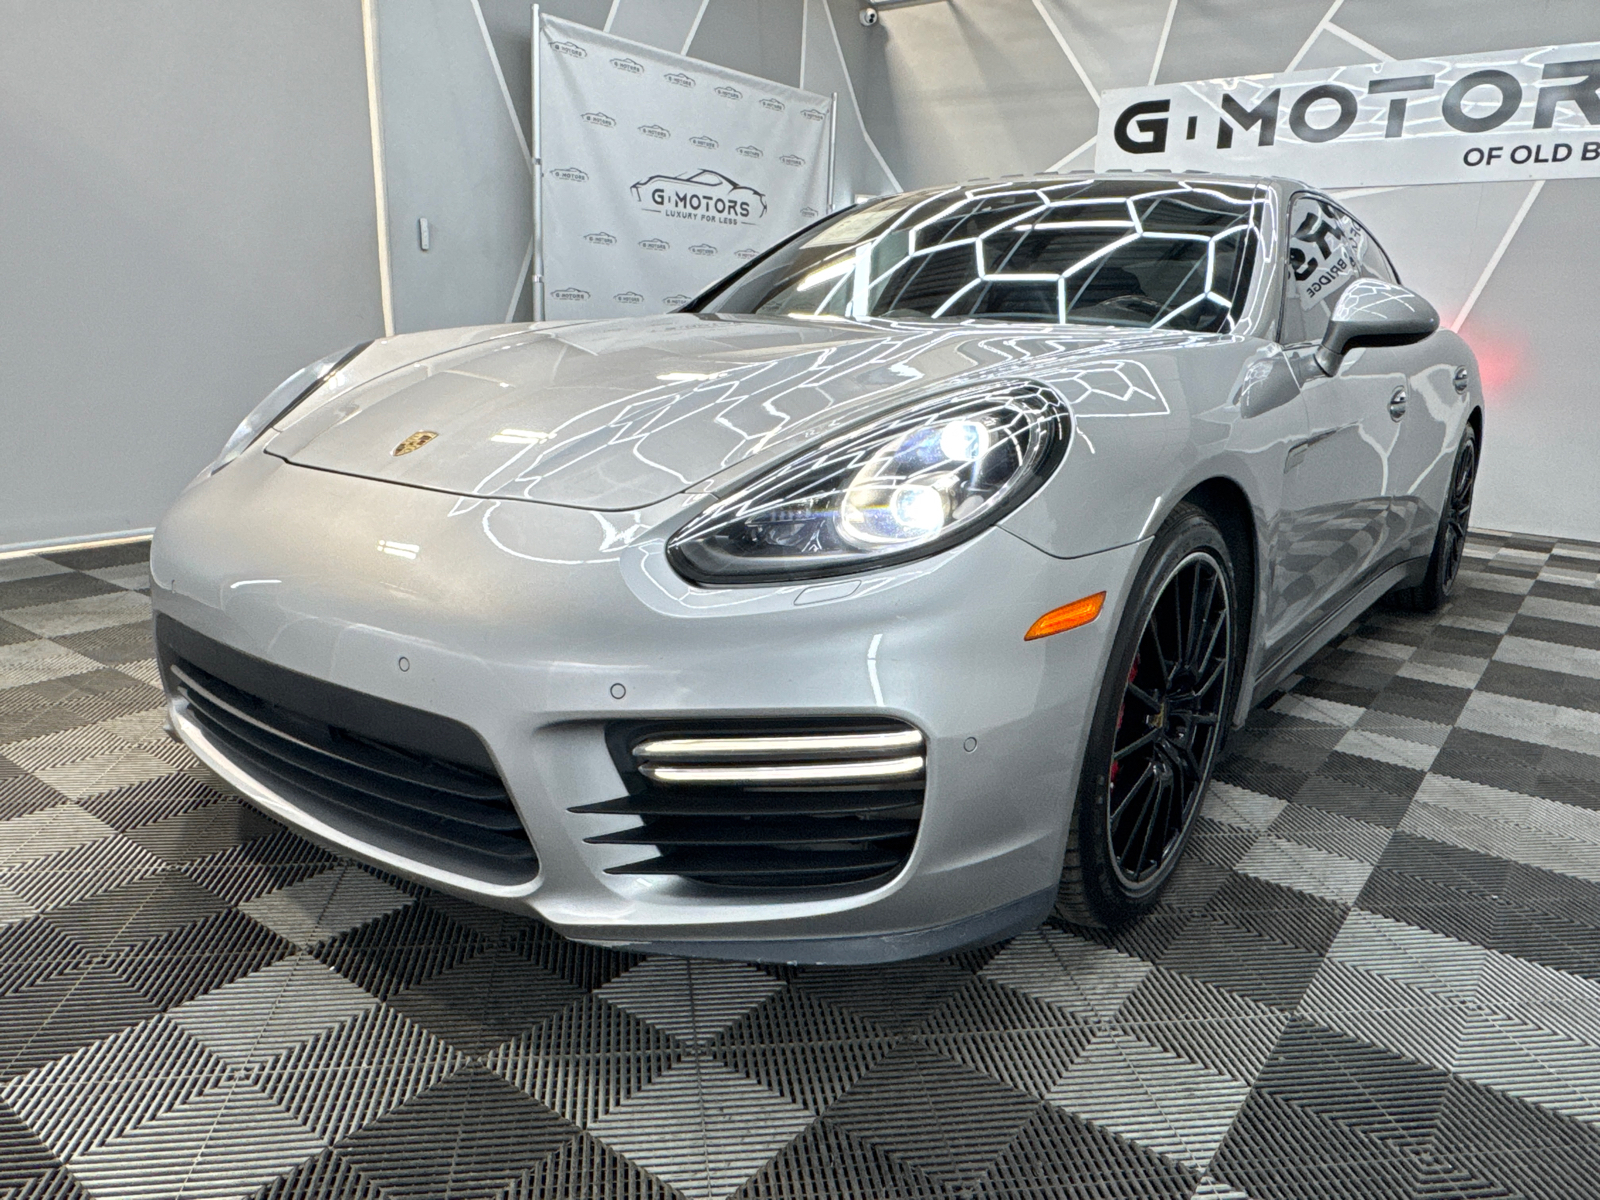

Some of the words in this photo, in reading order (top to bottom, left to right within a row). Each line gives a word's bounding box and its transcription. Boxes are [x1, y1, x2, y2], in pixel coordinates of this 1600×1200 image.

[1463, 146, 1504, 167] OF
[1510, 143, 1573, 165] OLD
[675, 190, 750, 217] MOTORS
[665, 209, 698, 220] LUXURY
[700, 215, 716, 223] FOR
[718, 216, 738, 226] LESS
